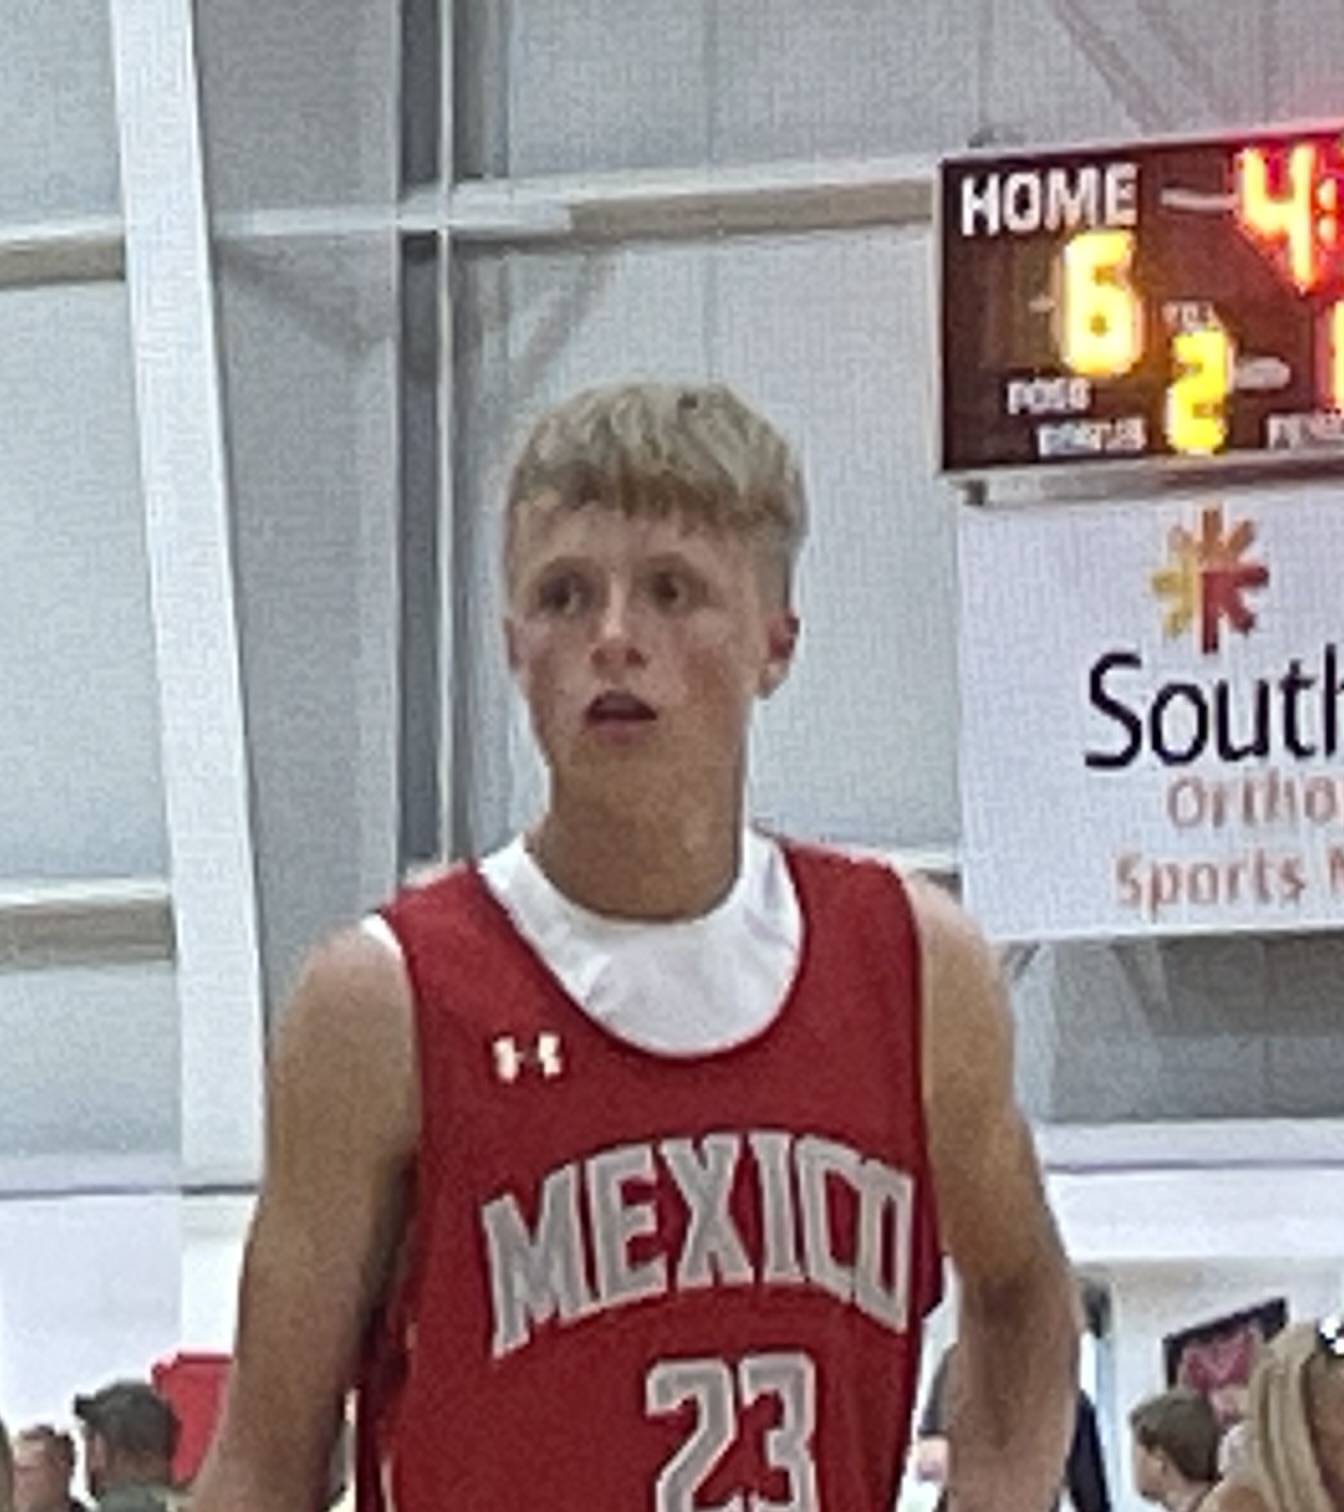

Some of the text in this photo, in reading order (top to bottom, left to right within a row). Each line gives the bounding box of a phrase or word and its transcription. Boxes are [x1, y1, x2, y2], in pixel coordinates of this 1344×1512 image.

[961, 163, 1139, 236] HOME
[1059, 228, 1142, 377] 6
[1165, 330, 1230, 455] 2
[1113, 850, 1307, 915] Sports
[480, 1129, 915, 1360] MEXICO
